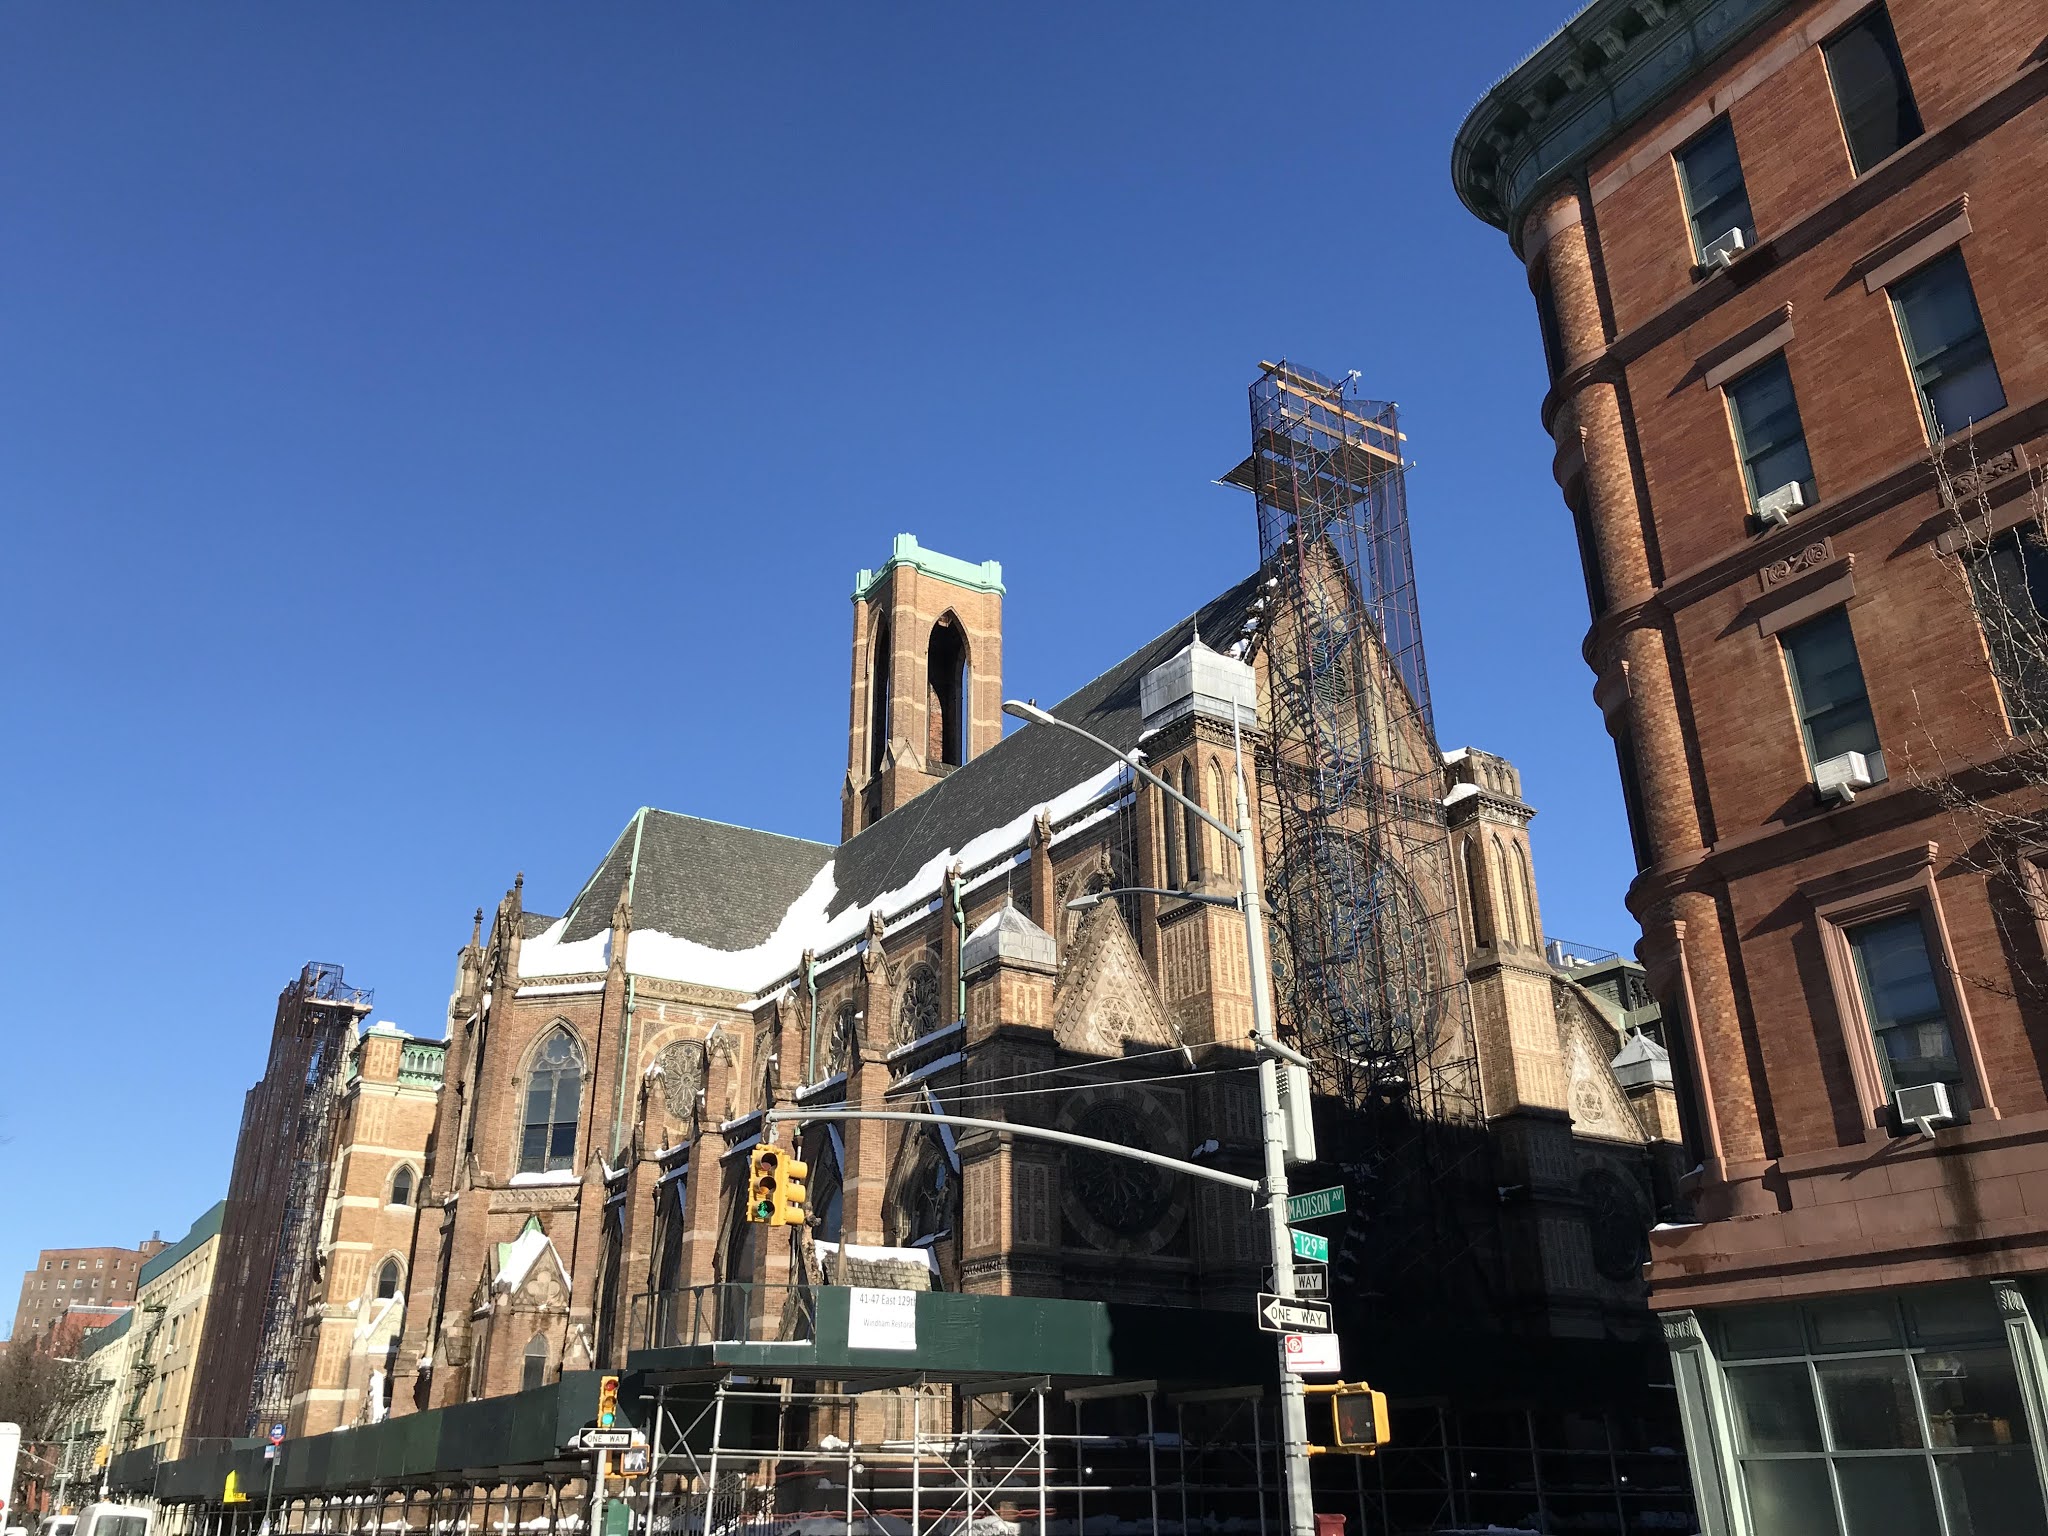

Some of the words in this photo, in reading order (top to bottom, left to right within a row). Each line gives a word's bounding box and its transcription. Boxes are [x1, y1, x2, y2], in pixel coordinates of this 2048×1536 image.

[1287, 1193, 1331, 1219] MADISON
[1332, 1190, 1342, 1201] AV
[1300, 1235, 1318, 1256] 129
[1318, 1240, 1326, 1250] ST
[1298, 1275, 1318, 1288] WAY
[860, 1293, 880, 1304] 41-47
[881, 1294, 896, 1306] East
[1271, 1306, 1292, 1321] ONE
[1301, 1310, 1322, 1325] WAY
[587, 1435, 603, 1443] ONE
[609, 1435, 626, 1443] WAY
